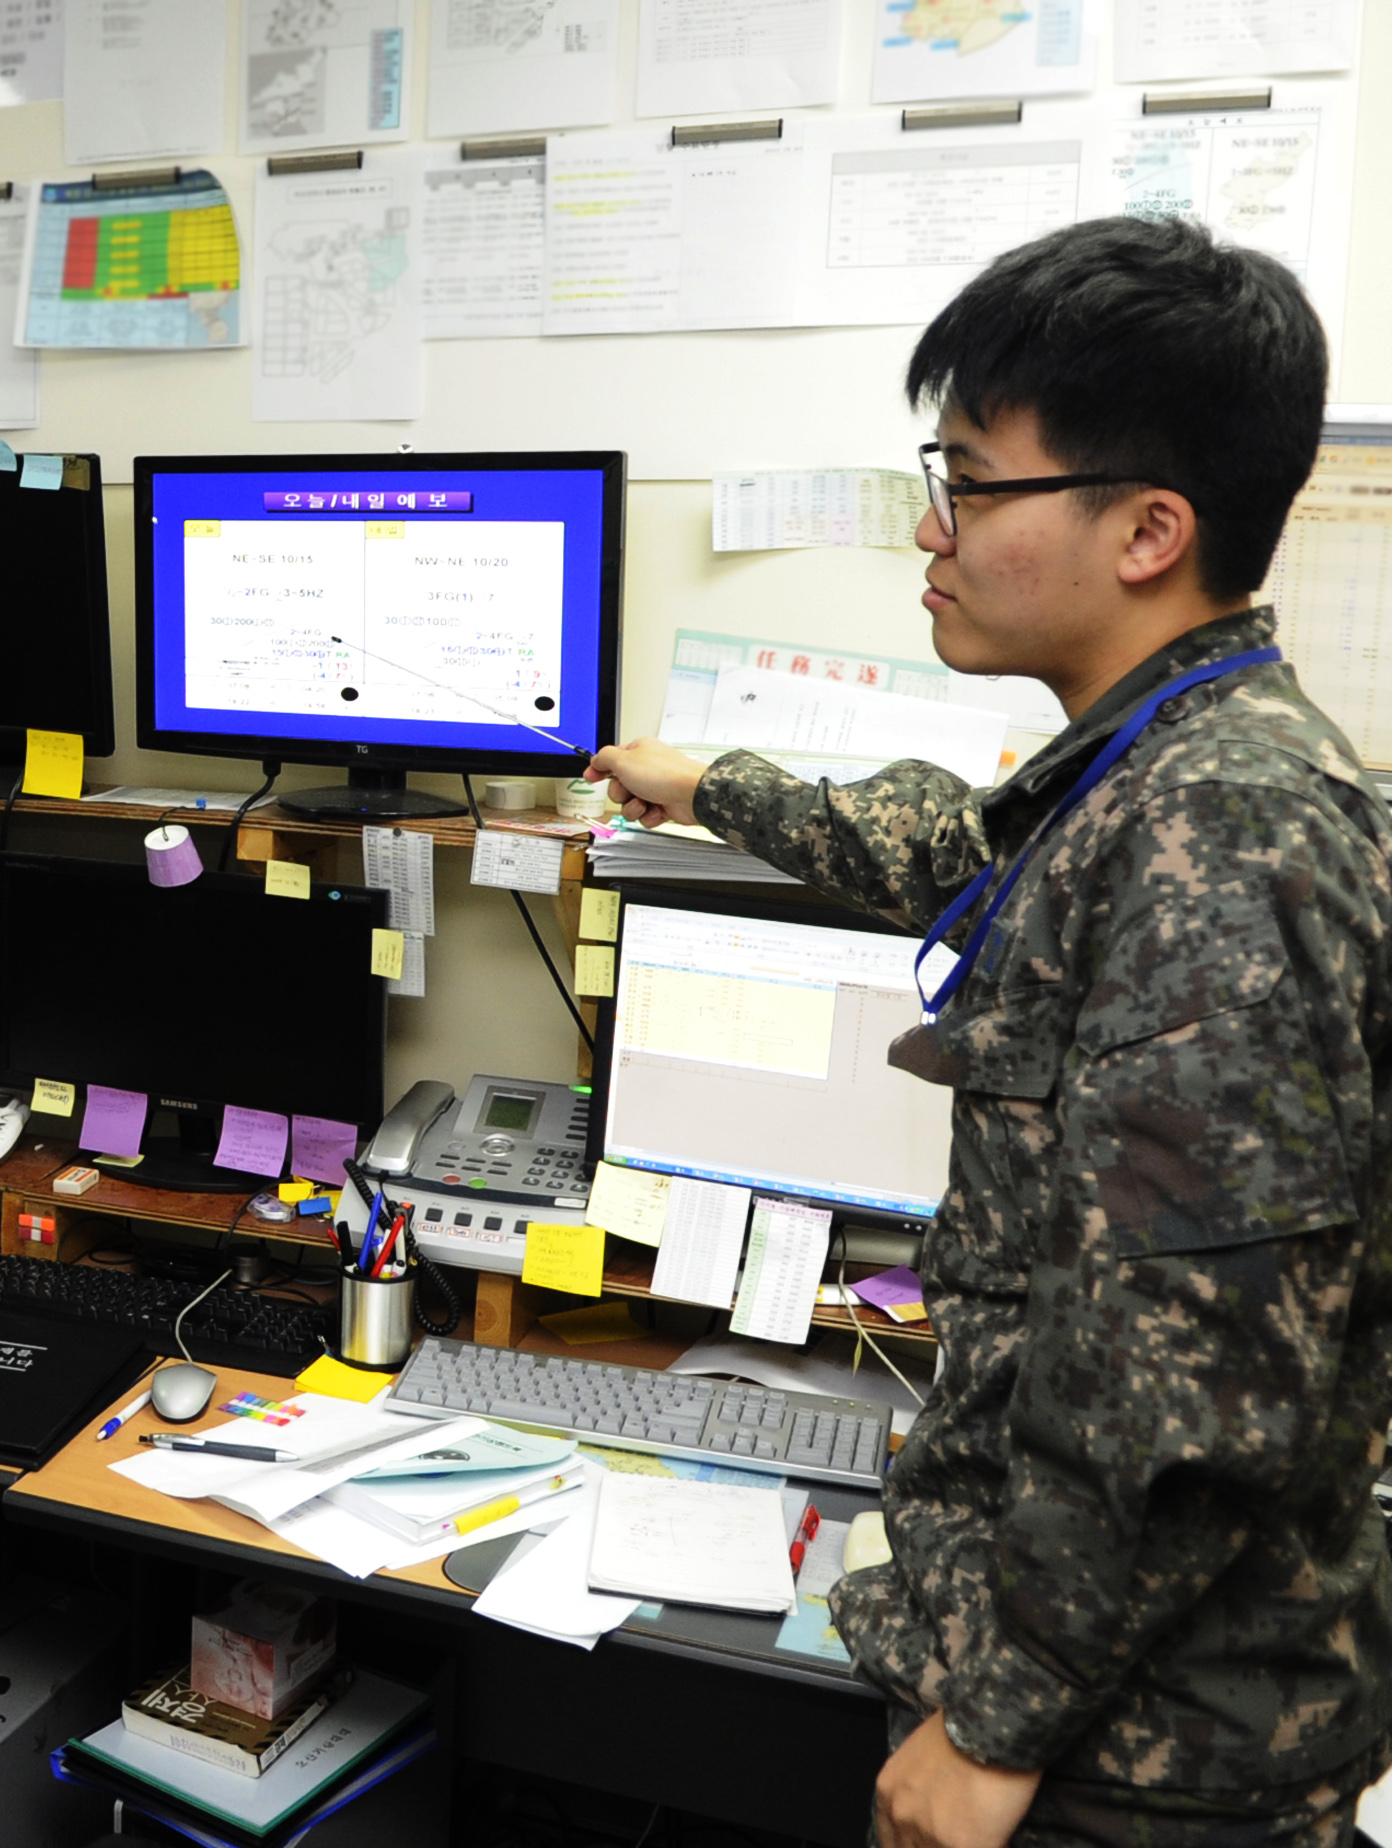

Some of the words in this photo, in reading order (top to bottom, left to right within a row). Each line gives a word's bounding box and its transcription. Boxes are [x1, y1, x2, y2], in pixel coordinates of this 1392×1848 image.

[474, 556, 508, 567] 10/20
[355, 744, 369, 754] TG
[159, 1098, 198, 1110] SAMSUNG
[141, 1688, 207, 1723] 경제
